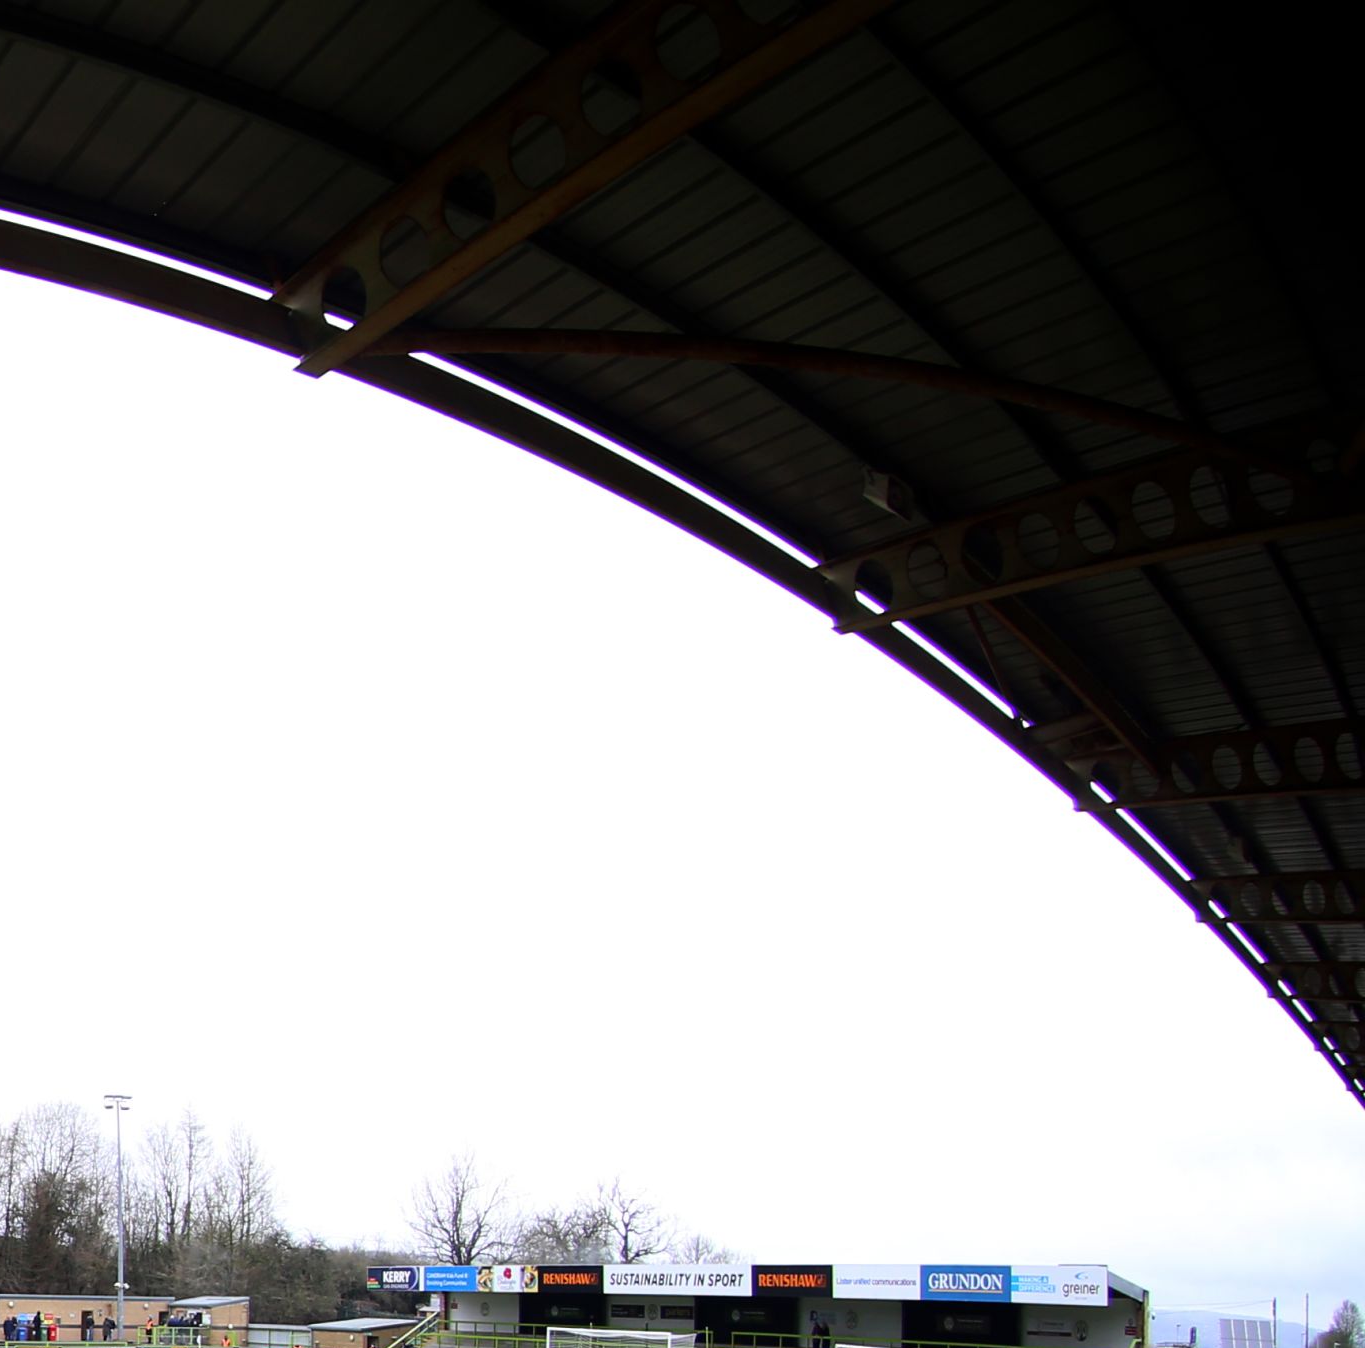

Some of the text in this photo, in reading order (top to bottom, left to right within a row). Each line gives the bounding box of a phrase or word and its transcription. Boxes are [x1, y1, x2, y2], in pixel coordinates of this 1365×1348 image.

[383, 1271, 411, 1283] KERRY
[543, 1273, 591, 1285] RENISHAW
[609, 1272, 744, 1288] SUSTAINABILITY IN SPORT
[758, 1273, 815, 1288] RENISHAW
[871, 1278, 917, 1286] communications
[928, 1272, 1003, 1290] GRUNDON
[1062, 1282, 1100, 1297] greiner
